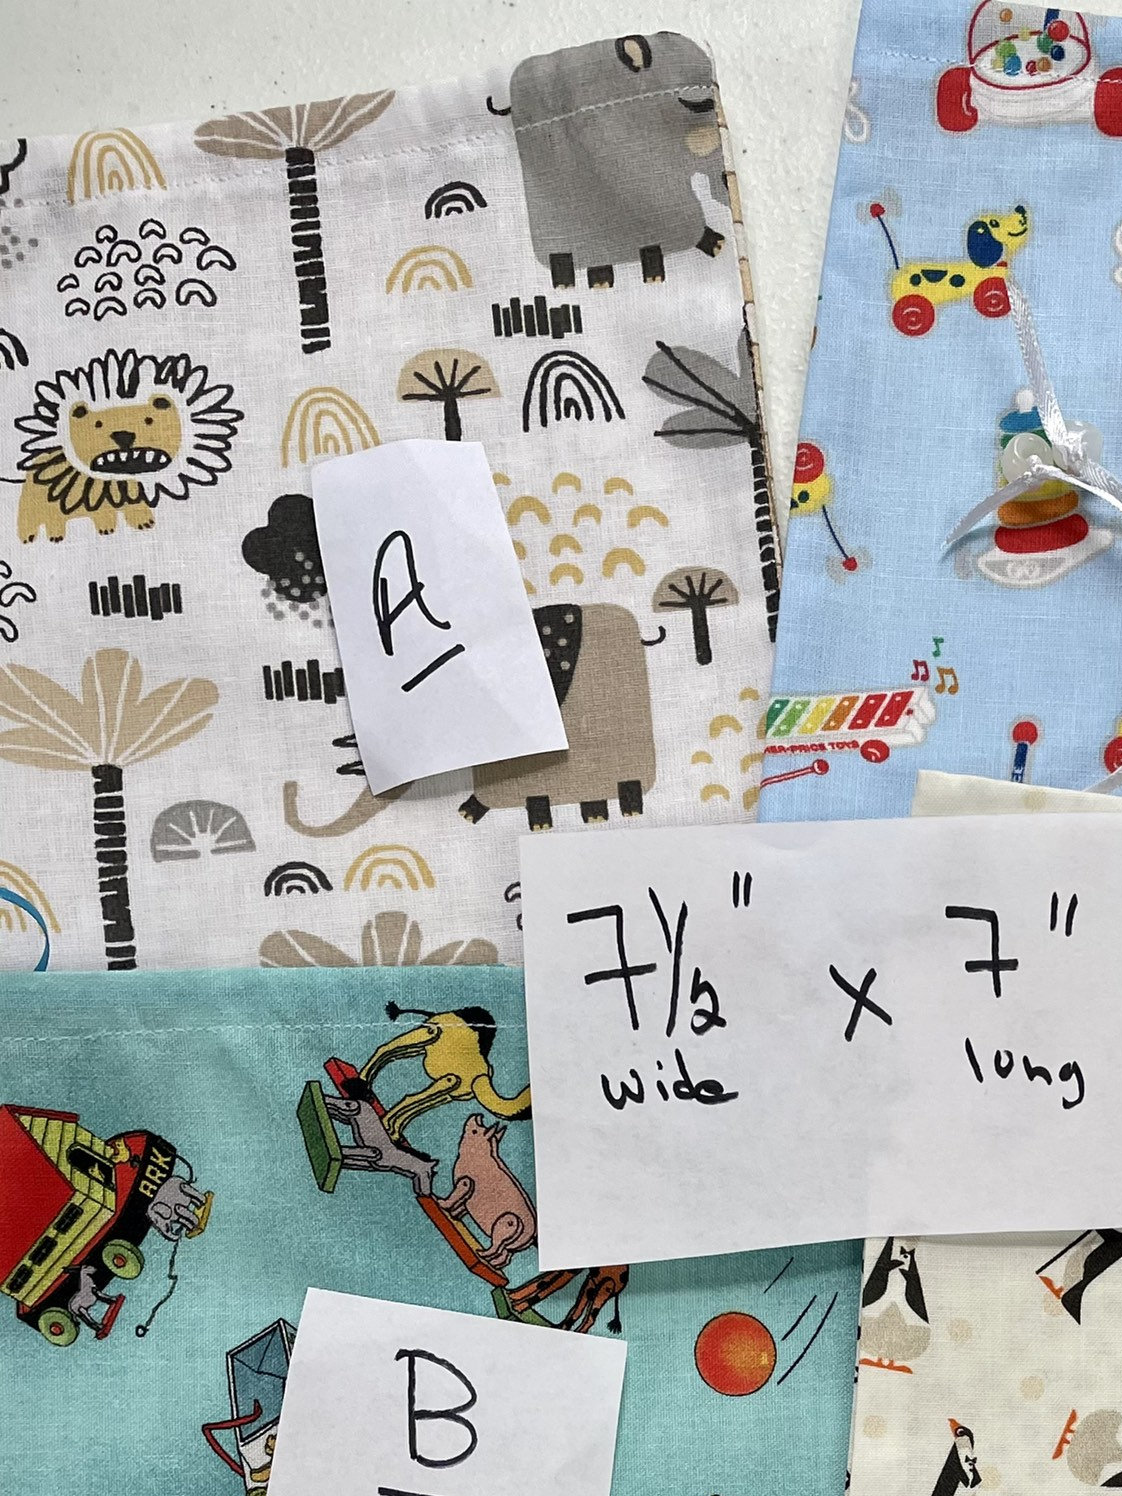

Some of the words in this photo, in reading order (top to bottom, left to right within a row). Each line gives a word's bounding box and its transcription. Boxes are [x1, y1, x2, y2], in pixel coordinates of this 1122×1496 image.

[373, 530, 452, 657] A
[601, 1048, 739, 1110] wide
[964, 1037, 1085, 1110] long
[139, 1146, 172, 1199] ARK
[395, 1348, 478, 1469] B
